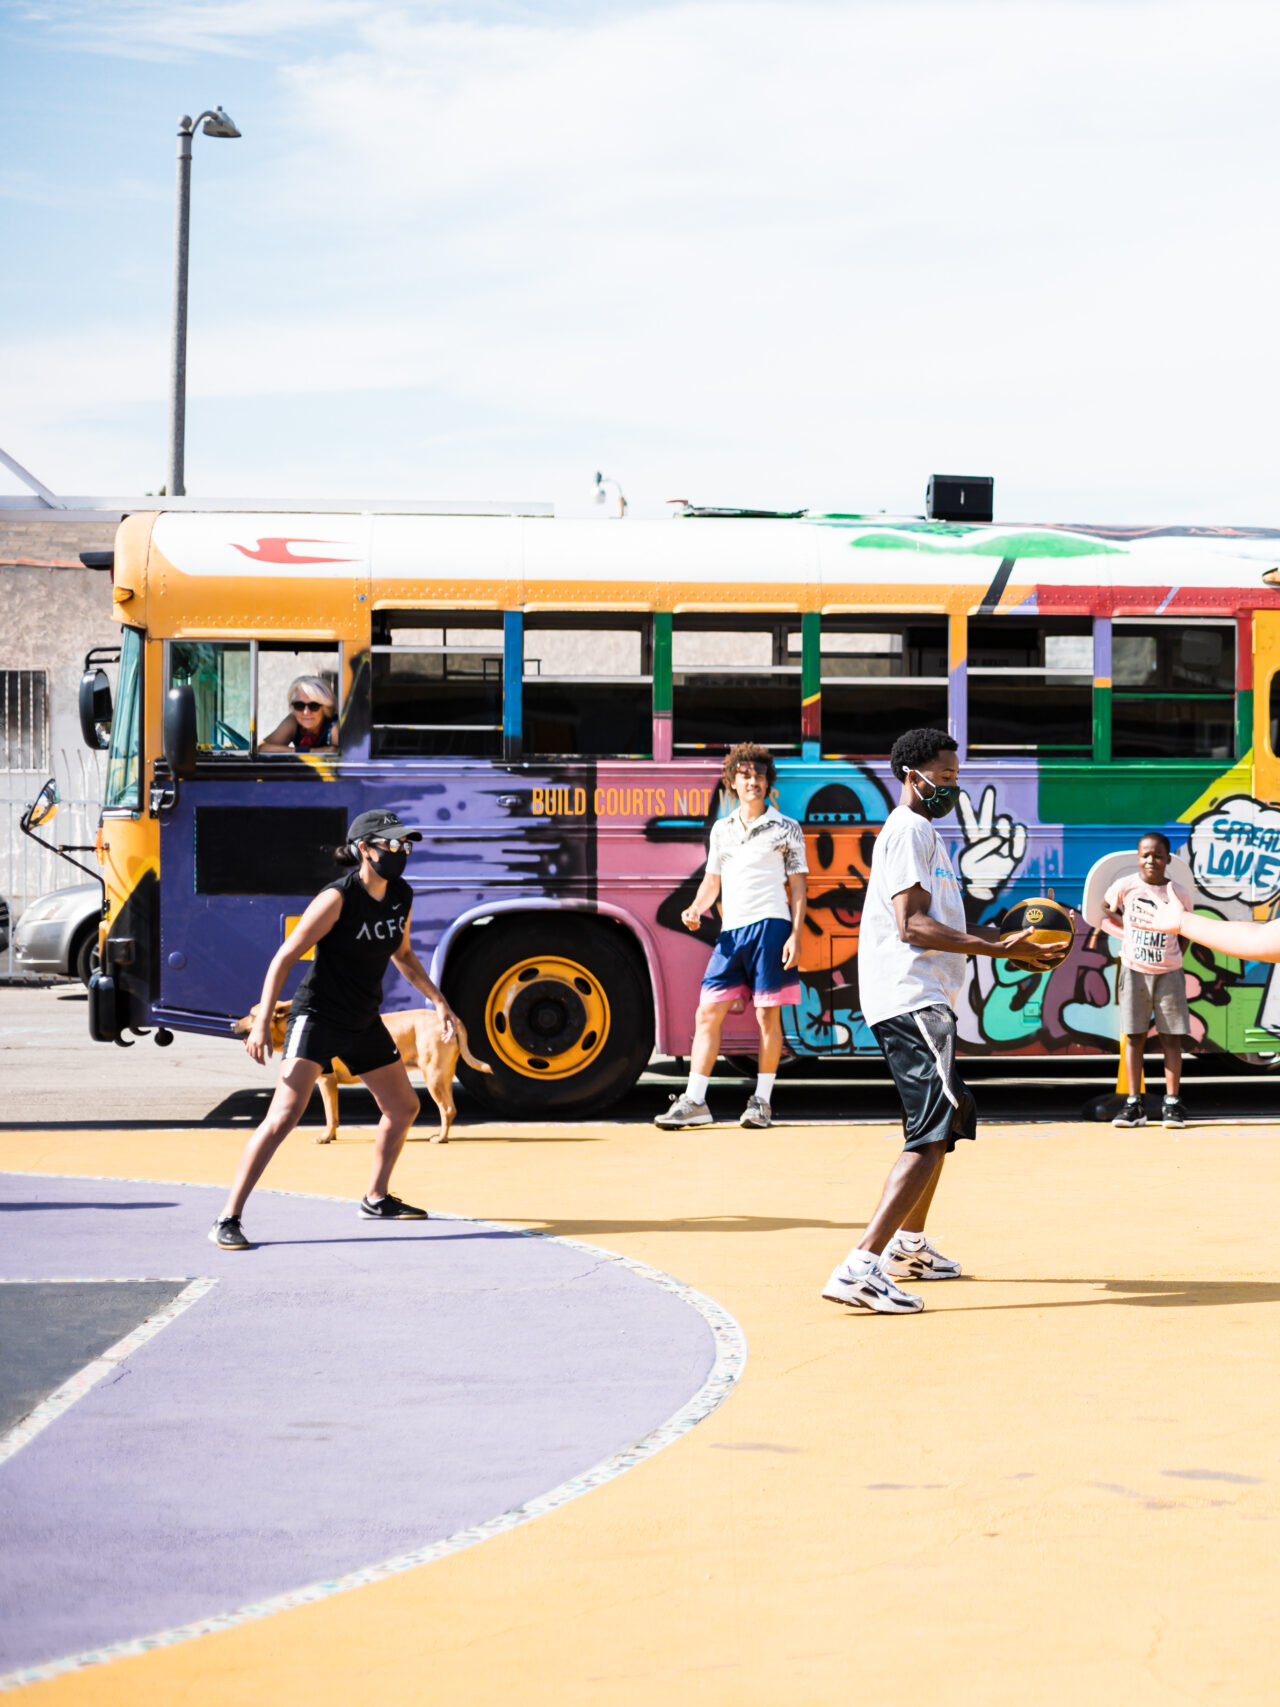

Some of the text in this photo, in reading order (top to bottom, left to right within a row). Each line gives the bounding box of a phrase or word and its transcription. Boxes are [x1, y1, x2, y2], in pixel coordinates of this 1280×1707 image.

[532, 787, 587, 816] BUILD
[593, 787, 667, 817] COURTS
[673, 787, 712, 817] NOT
[1131, 929, 1168, 949] THEME
